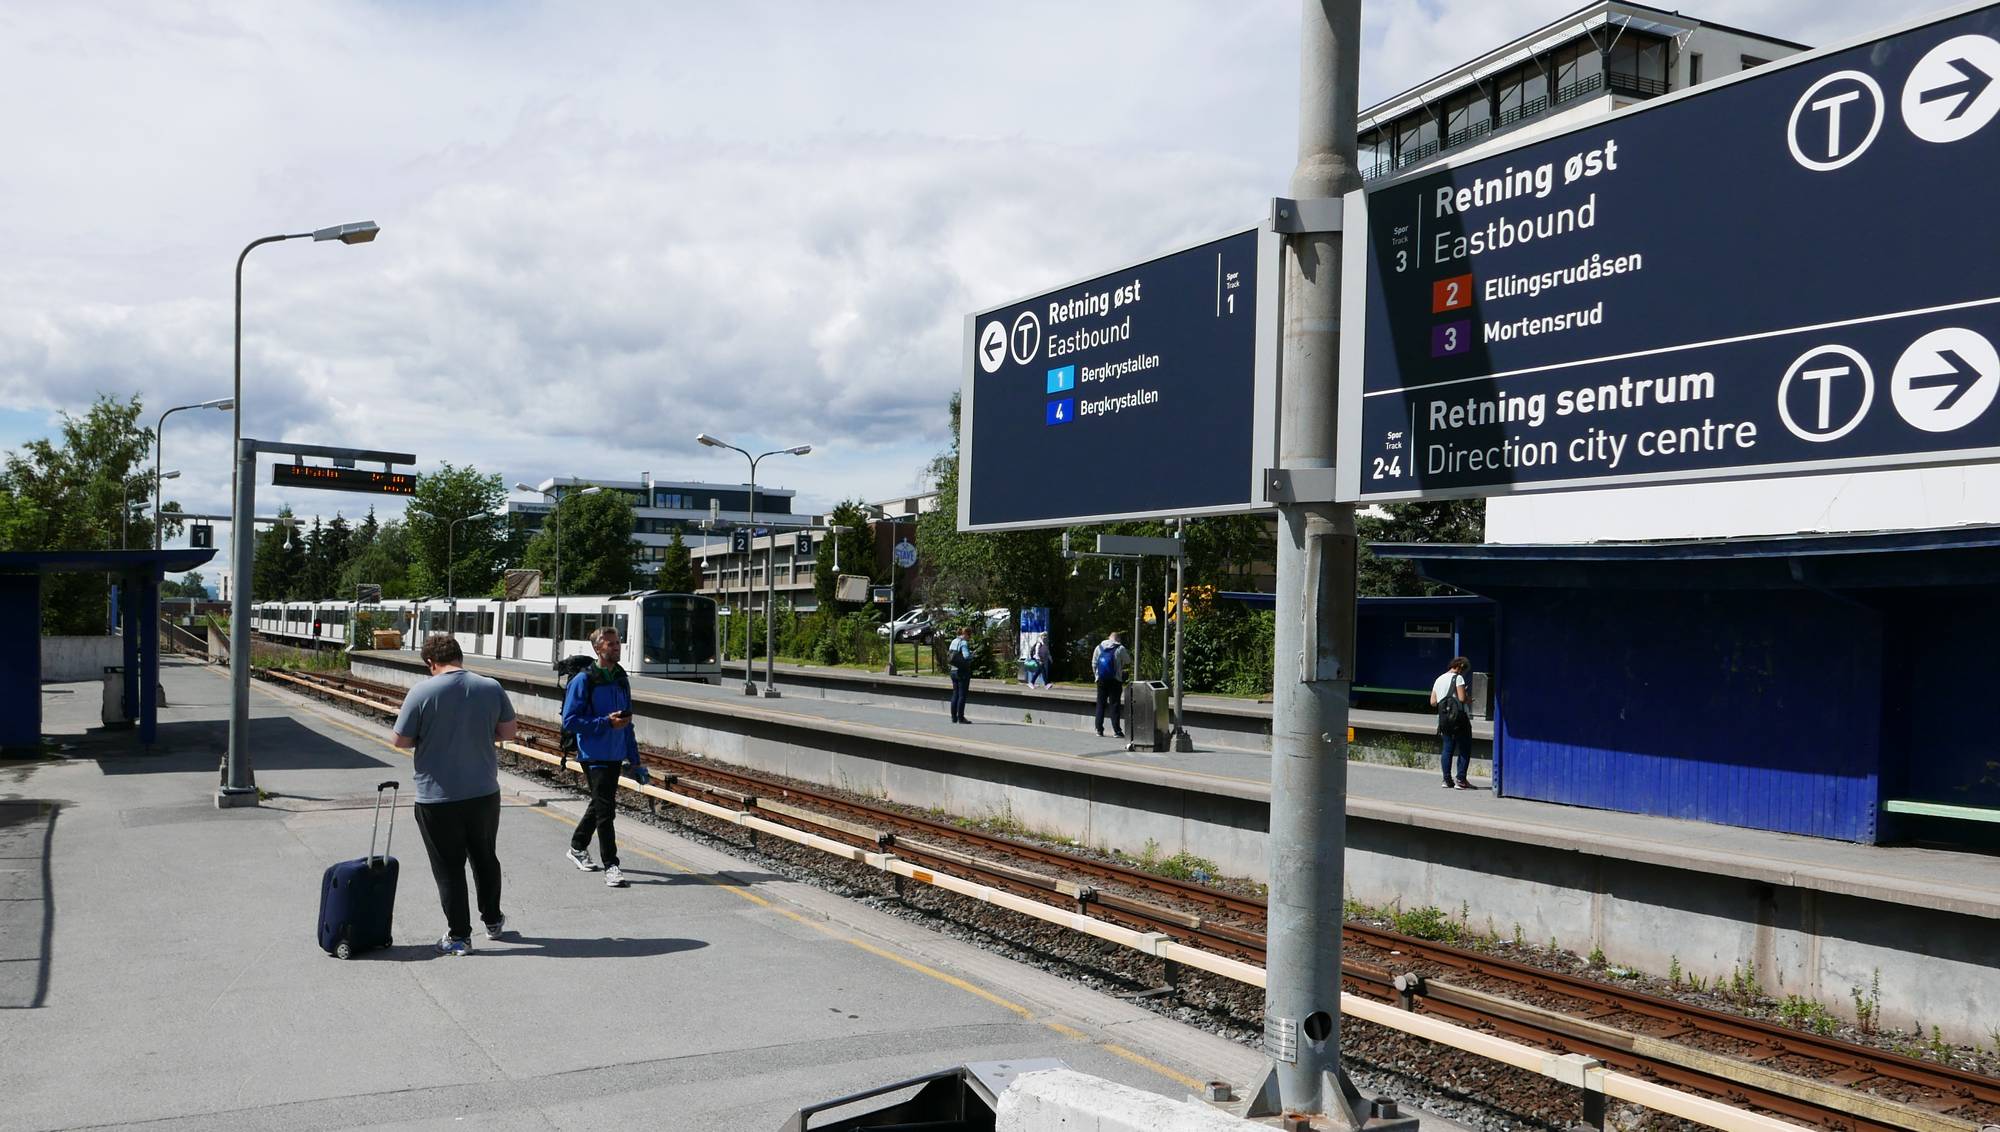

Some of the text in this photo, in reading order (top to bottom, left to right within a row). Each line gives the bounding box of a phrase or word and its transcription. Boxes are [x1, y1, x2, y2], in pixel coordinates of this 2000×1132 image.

[1435, 140, 1618, 218] Retning øst
[1393, 225, 1409, 236] Spor
[1435, 194, 1597, 264] Eastbound
[1391, 235, 1408, 245] Track
[1395, 250, 1407, 273] 3
[1226, 271, 1239, 281] Spor
[1226, 279, 1240, 289] Track
[1445, 251, 1642, 307] 2 Ellingsrudåsen
[1049, 279, 1141, 325] Retning øst
[1227, 294, 1234, 314] 1
[1048, 315, 1131, 358] Eastbound
[1444, 301, 1603, 351] 3 Mortensrud
[1057, 354, 1160, 388] 1 Bergkrystallen
[1056, 388, 1159, 420] 4 Bergkrystallen
[1429, 371, 1715, 431] Retning sentrum
[1385, 440, 1403, 450] Track
[1387, 431, 1403, 441] Spor
[1428, 418, 1757, 474] Direction city centre
[198, 532, 205, 545] 1
[737, 538, 745, 550] 2
[800, 541, 809, 553] 3
[1114, 567, 1120, 577] 4
